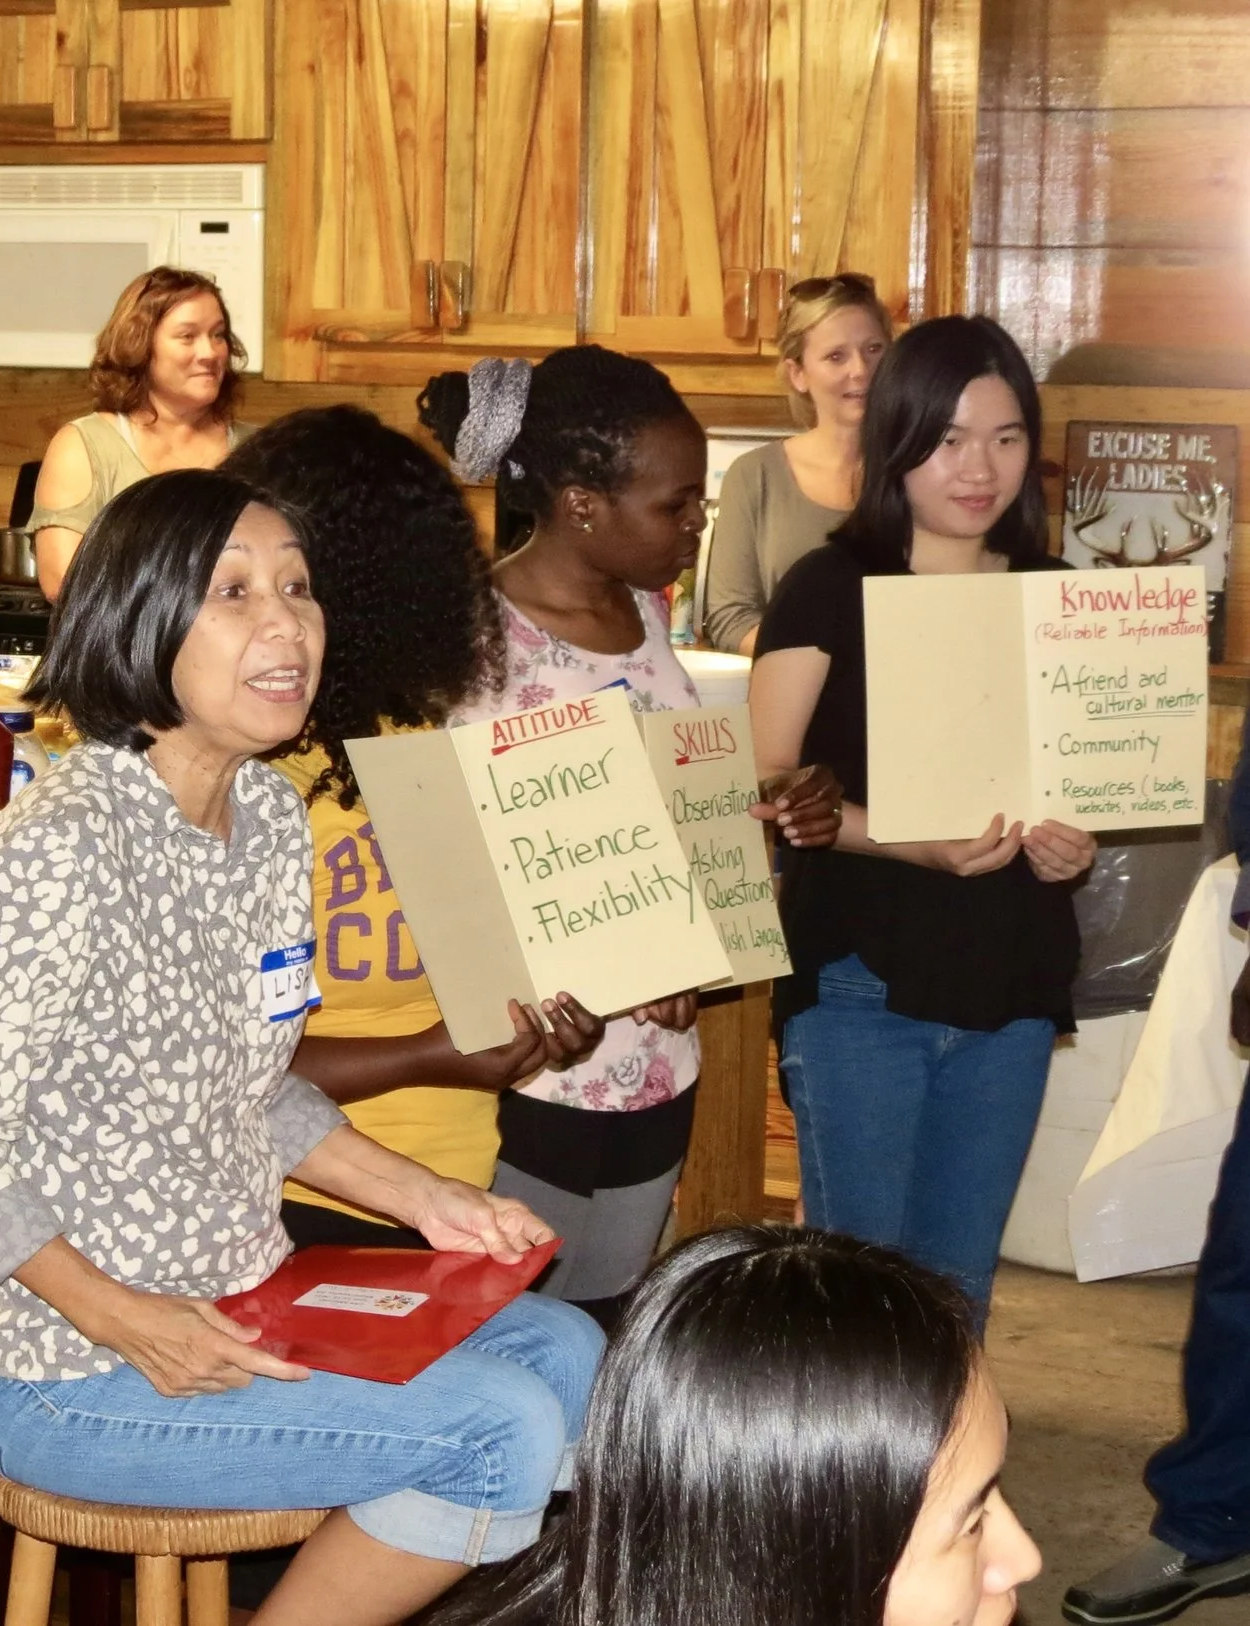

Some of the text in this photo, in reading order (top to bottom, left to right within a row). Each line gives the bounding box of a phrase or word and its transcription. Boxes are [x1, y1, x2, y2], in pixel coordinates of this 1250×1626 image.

[1088, 431, 1171, 460] EXCUSE
[1108, 463, 1188, 491] LADIES
[1061, 573, 1199, 623] Knowledge
[1035, 615, 1209, 645] (Reliable Information)
[1073, 664, 1130, 694] friend
[1138, 664, 1168, 688] and
[1086, 688, 1205, 715] cultural mentor
[492, 697, 600, 746] ATTITUDE
[672, 717, 737, 756] SKILLS
[1058, 729, 1161, 763] Community
[487, 747, 615, 815] Learner
[1062, 777, 1135, 799] Resources
[672, 780, 760, 825] Observation
[510, 824, 659, 884] Patience
[690, 836, 746, 882] Asking
[532, 863, 695, 944] Flexibility
[283, 946, 307, 961] Hello
